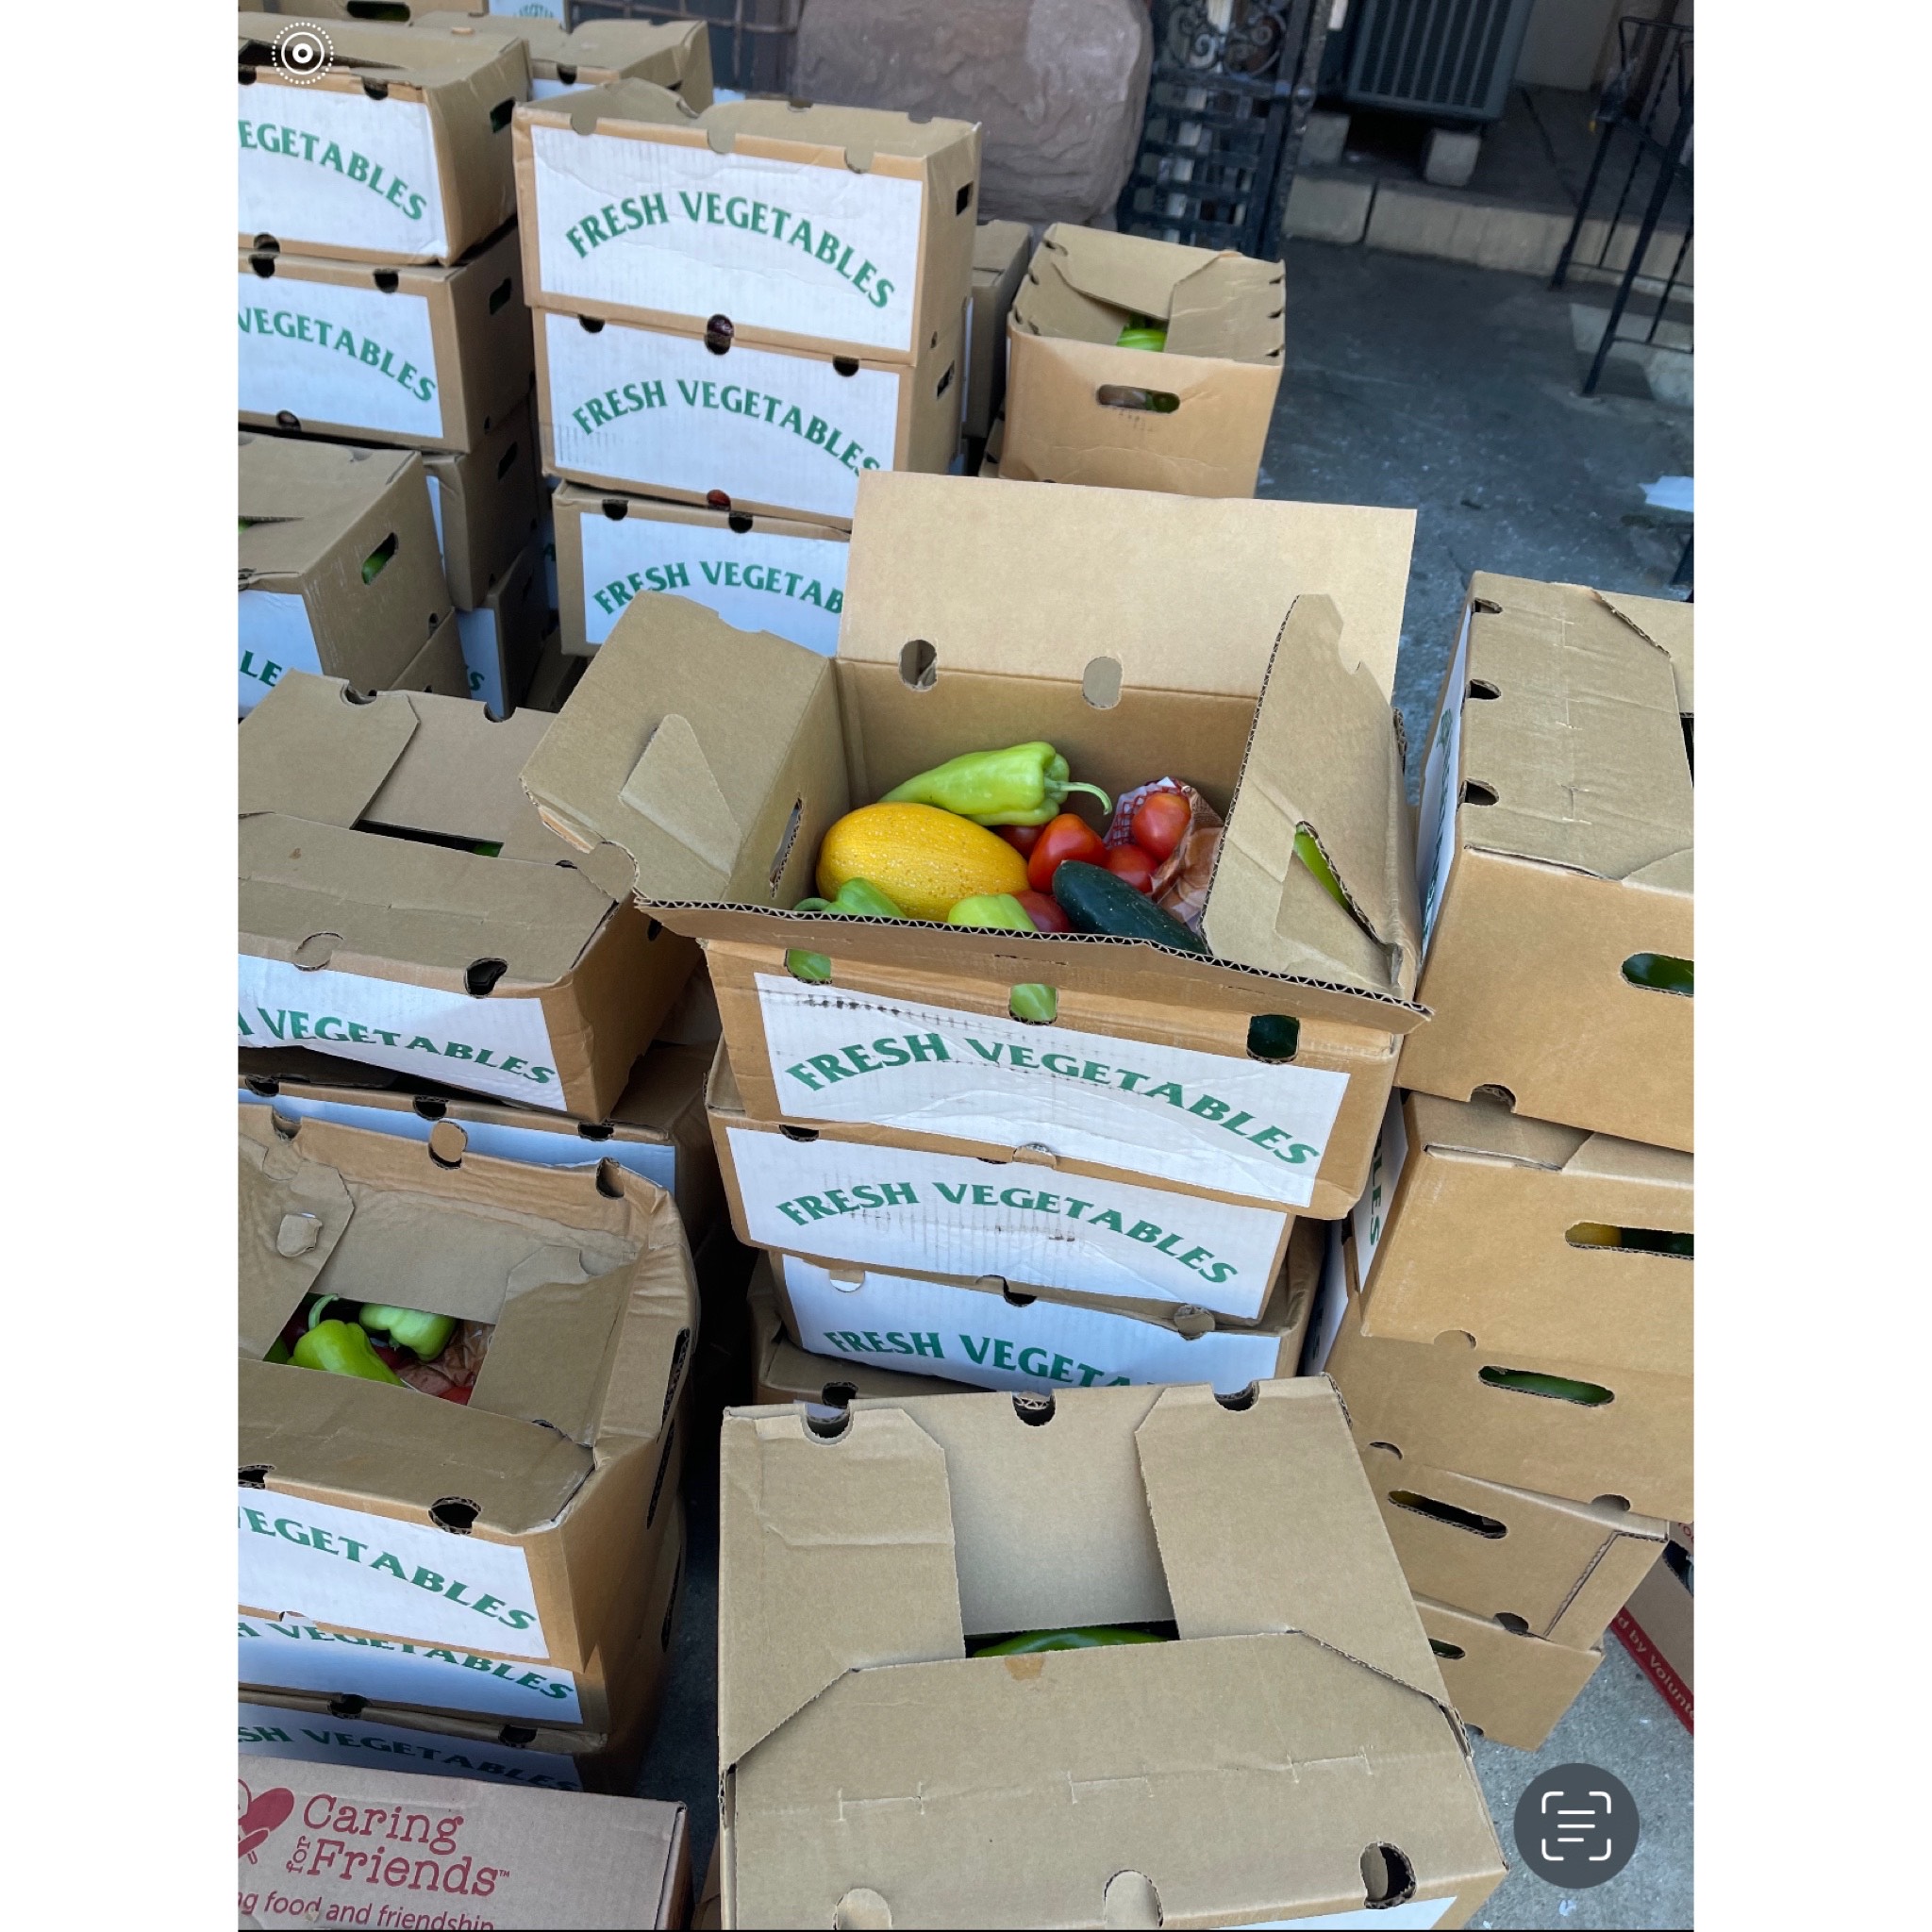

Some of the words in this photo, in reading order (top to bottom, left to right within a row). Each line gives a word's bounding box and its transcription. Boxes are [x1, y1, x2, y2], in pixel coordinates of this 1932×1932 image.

[565, 192, 669, 258] FRESH
[678, 191, 894, 308] VEGETABLES
[572, 379, 668, 436] FRESH
[592, 561, 690, 615] FRESH
[257, 1008, 556, 1084] VEGETABLES
[785, 1033, 954, 1091] FRESH
[964, 1037, 1321, 1167] VEGETABLES
[775, 1181, 921, 1227] FRESH
[932, 1181, 1240, 1285] VEGETABLES
[824, 1331, 945, 1359] FRESH
[238, 1506, 537, 1631] EGETABLES
[286, 1836, 311, 1874] for
[303, 1793, 464, 1856] Caring
[263, 1890, 323, 1916] food
[325, 1903, 373, 1925] and
